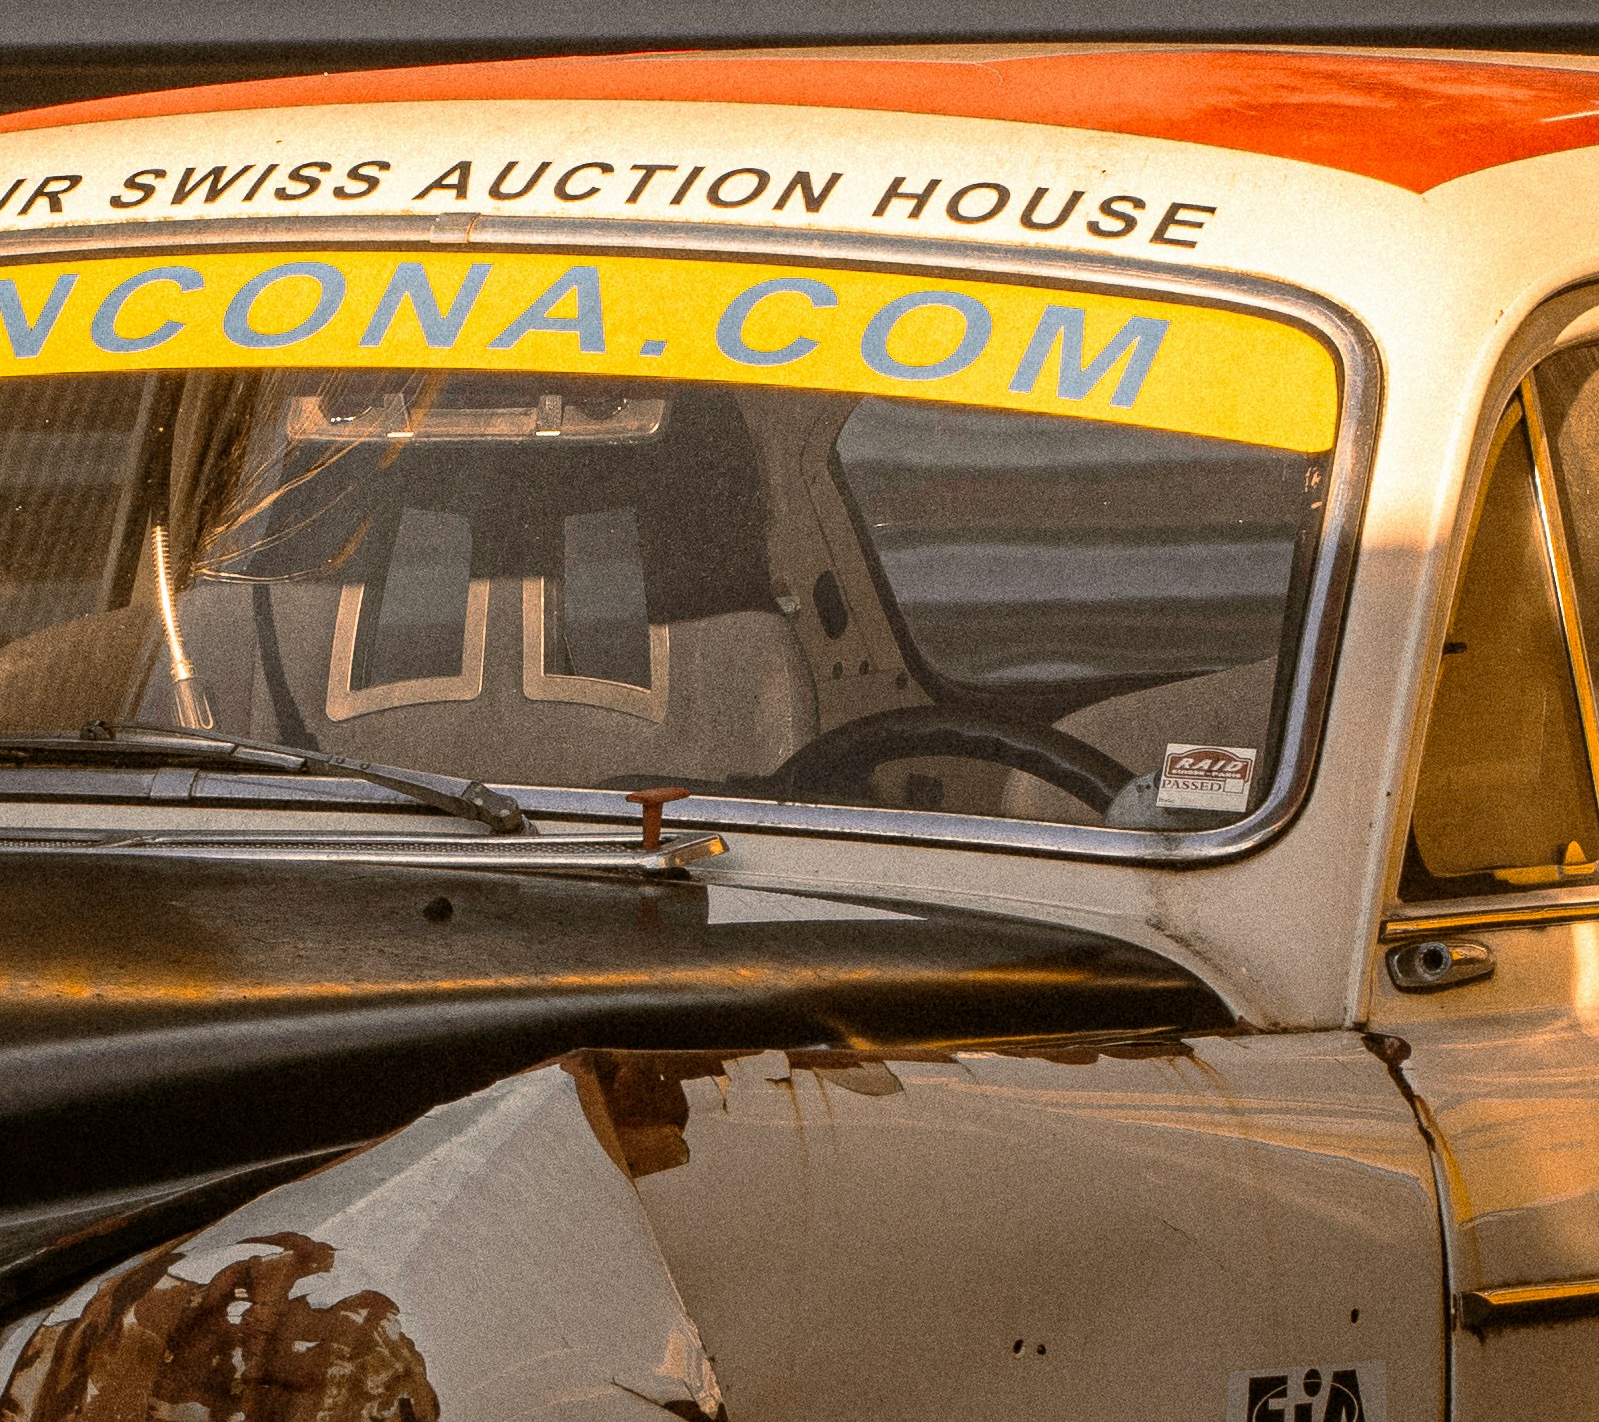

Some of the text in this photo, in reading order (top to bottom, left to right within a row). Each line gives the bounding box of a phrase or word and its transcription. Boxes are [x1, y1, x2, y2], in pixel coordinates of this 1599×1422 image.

[110, 159, 393, 210] SWISS
[412, 159, 845, 214] AUCTION
[871, 176, 1220, 250] HOUSE
[1175, 757, 1243, 772] RAID
[1161, 778, 1222, 792] PASSED
